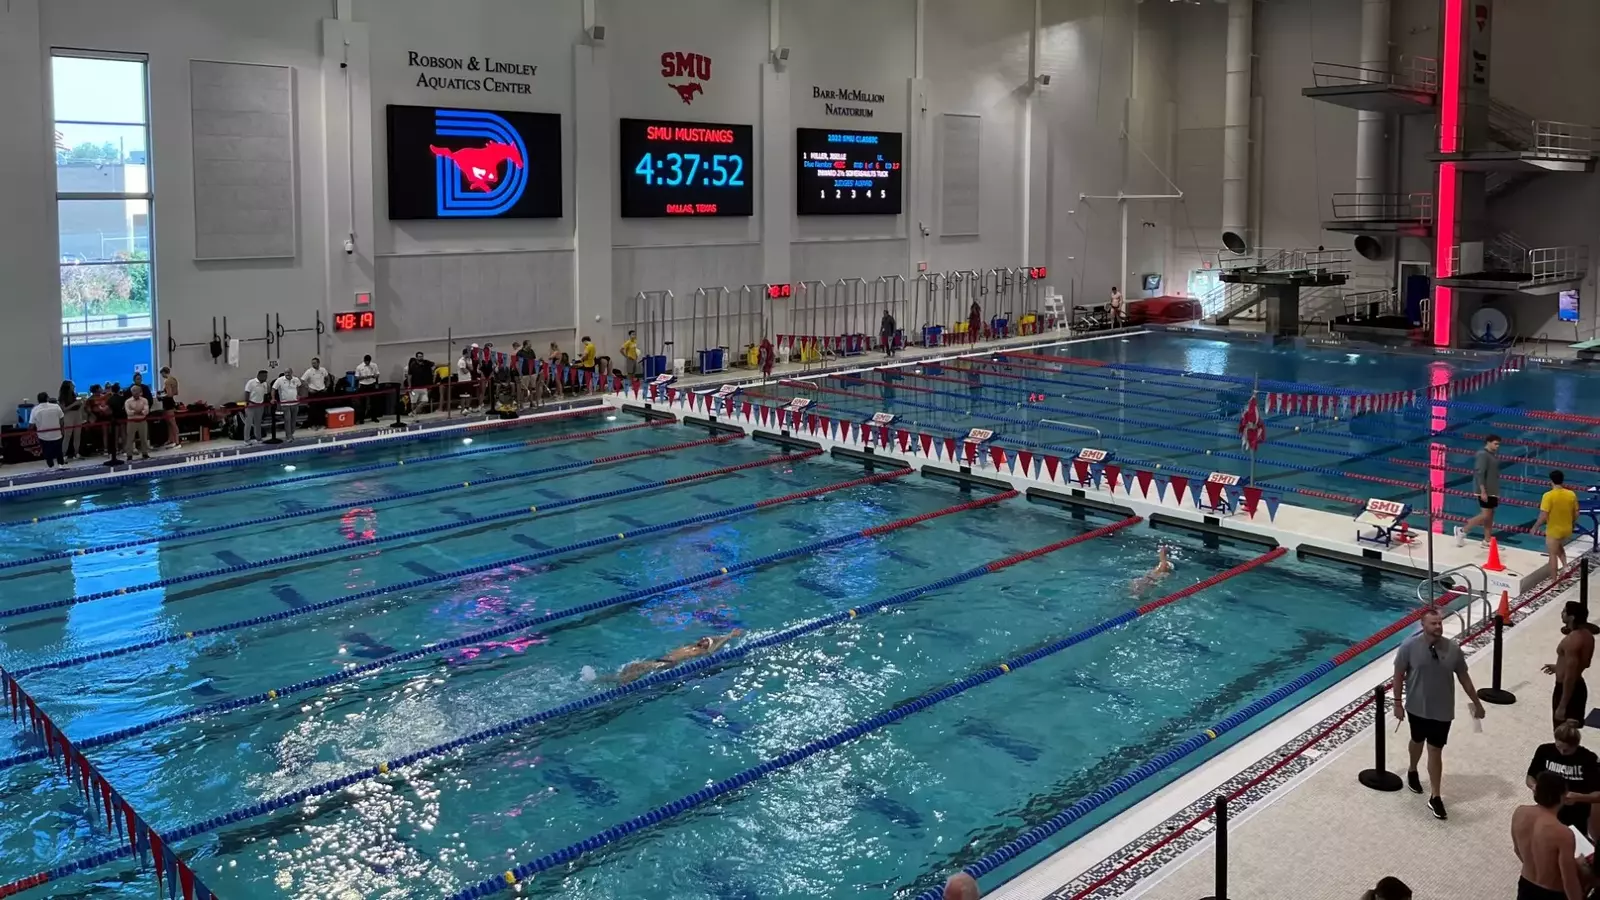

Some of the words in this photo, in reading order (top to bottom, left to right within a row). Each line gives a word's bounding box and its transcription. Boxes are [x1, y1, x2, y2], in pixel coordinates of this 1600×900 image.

[408, 51, 463, 70] ROBSON
[467, 56, 480, 71] &
[485, 57, 538, 76] LINDLEY
[661, 52, 712, 81] SMU
[416, 73, 481, 91] AQUATICS
[483, 77, 532, 94] CENTER
[825, 103, 873, 117] NATATORIUM
[647, 126, 672, 140] SMU
[675, 127, 734, 143] MUSTANGS
[635, 152, 744, 186] 4:37:52
[820, 190, 825, 199] 1
[836, 190, 841, 199] 2
[851, 190, 856, 199] 3
[866, 190, 871, 199] 4
[881, 190, 886, 199] 5
[666, 203, 694, 214] DALLAS,
[696, 204, 717, 213] TEXAS
[971, 429, 990, 438] SMU
[1081, 449, 1103, 460] SMU
[1212, 474, 1236, 485] SMU
[1369, 501, 1401, 515] SMU
